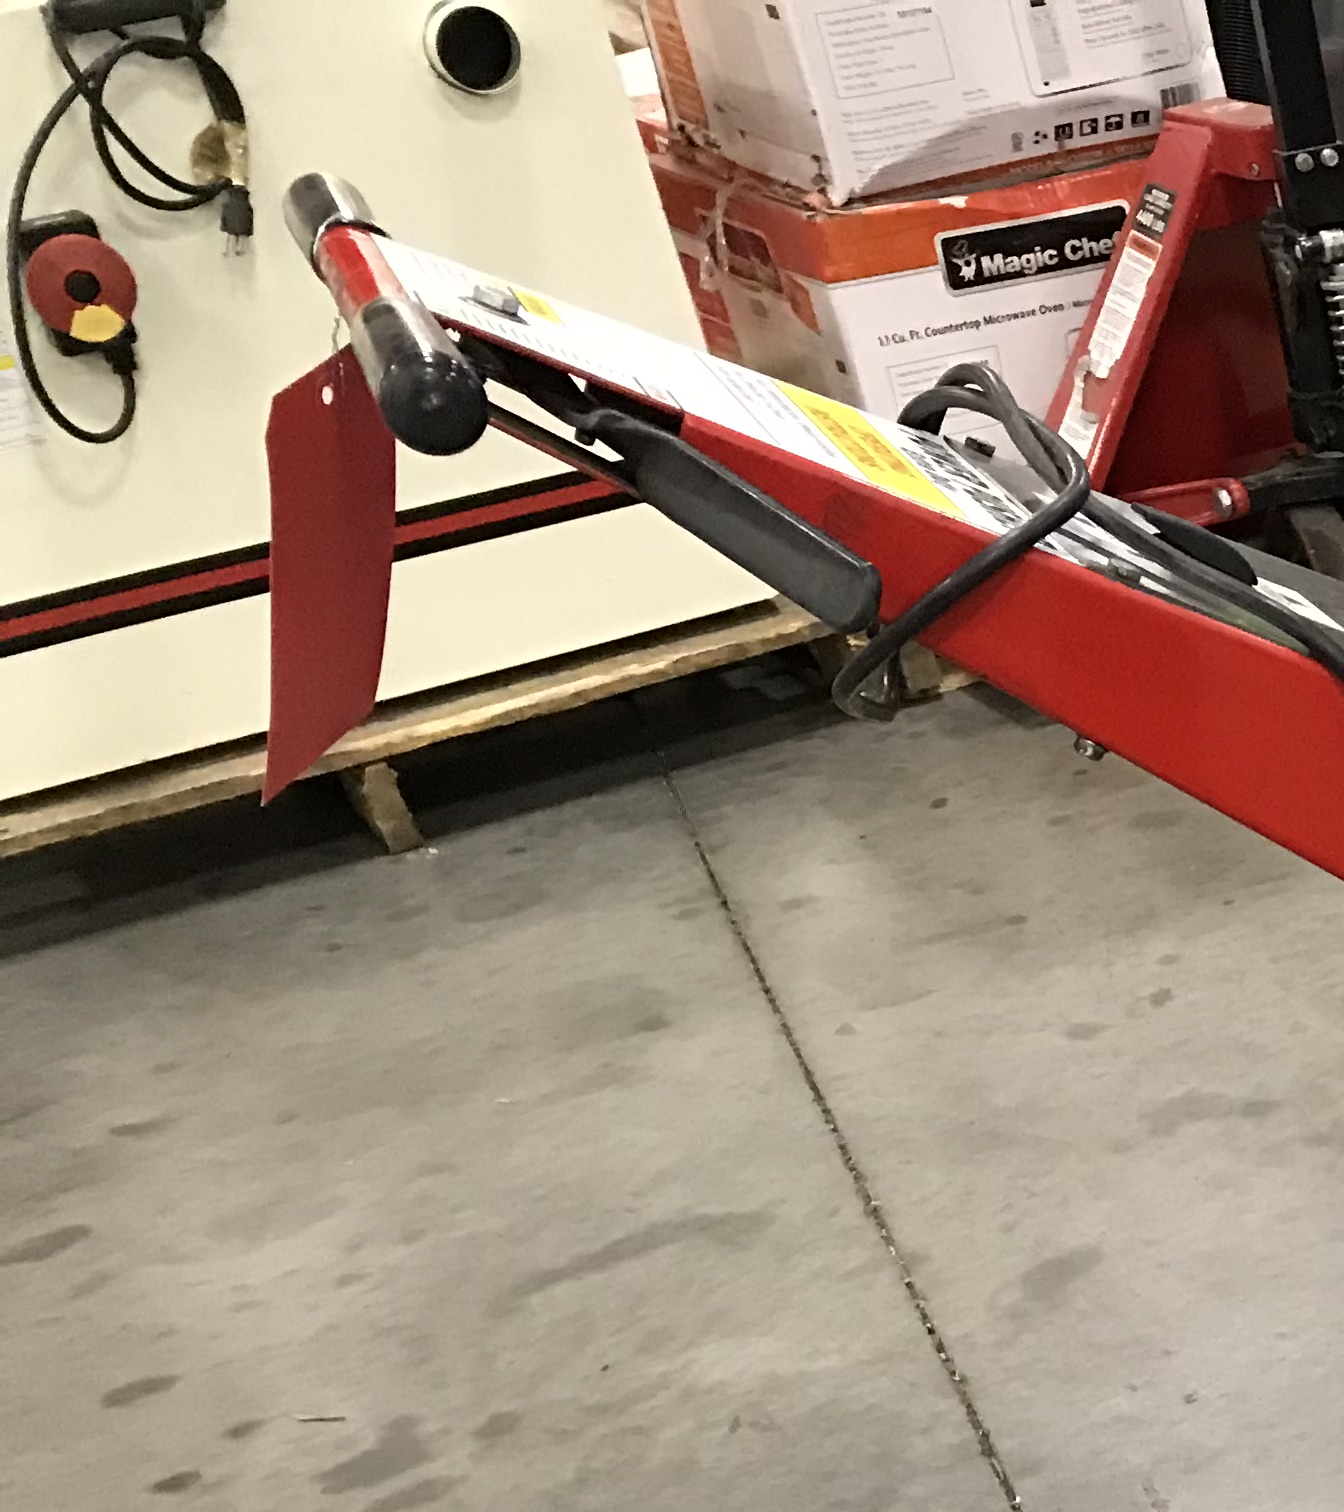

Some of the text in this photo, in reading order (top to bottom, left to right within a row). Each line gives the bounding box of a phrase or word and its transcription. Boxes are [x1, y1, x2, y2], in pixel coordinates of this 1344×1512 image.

[980, 246, 1059, 277] Magic
[924, 319, 982, 338] Countertop
[982, 308, 1037, 326] Microwave
[1038, 302, 1065, 315] Oven
